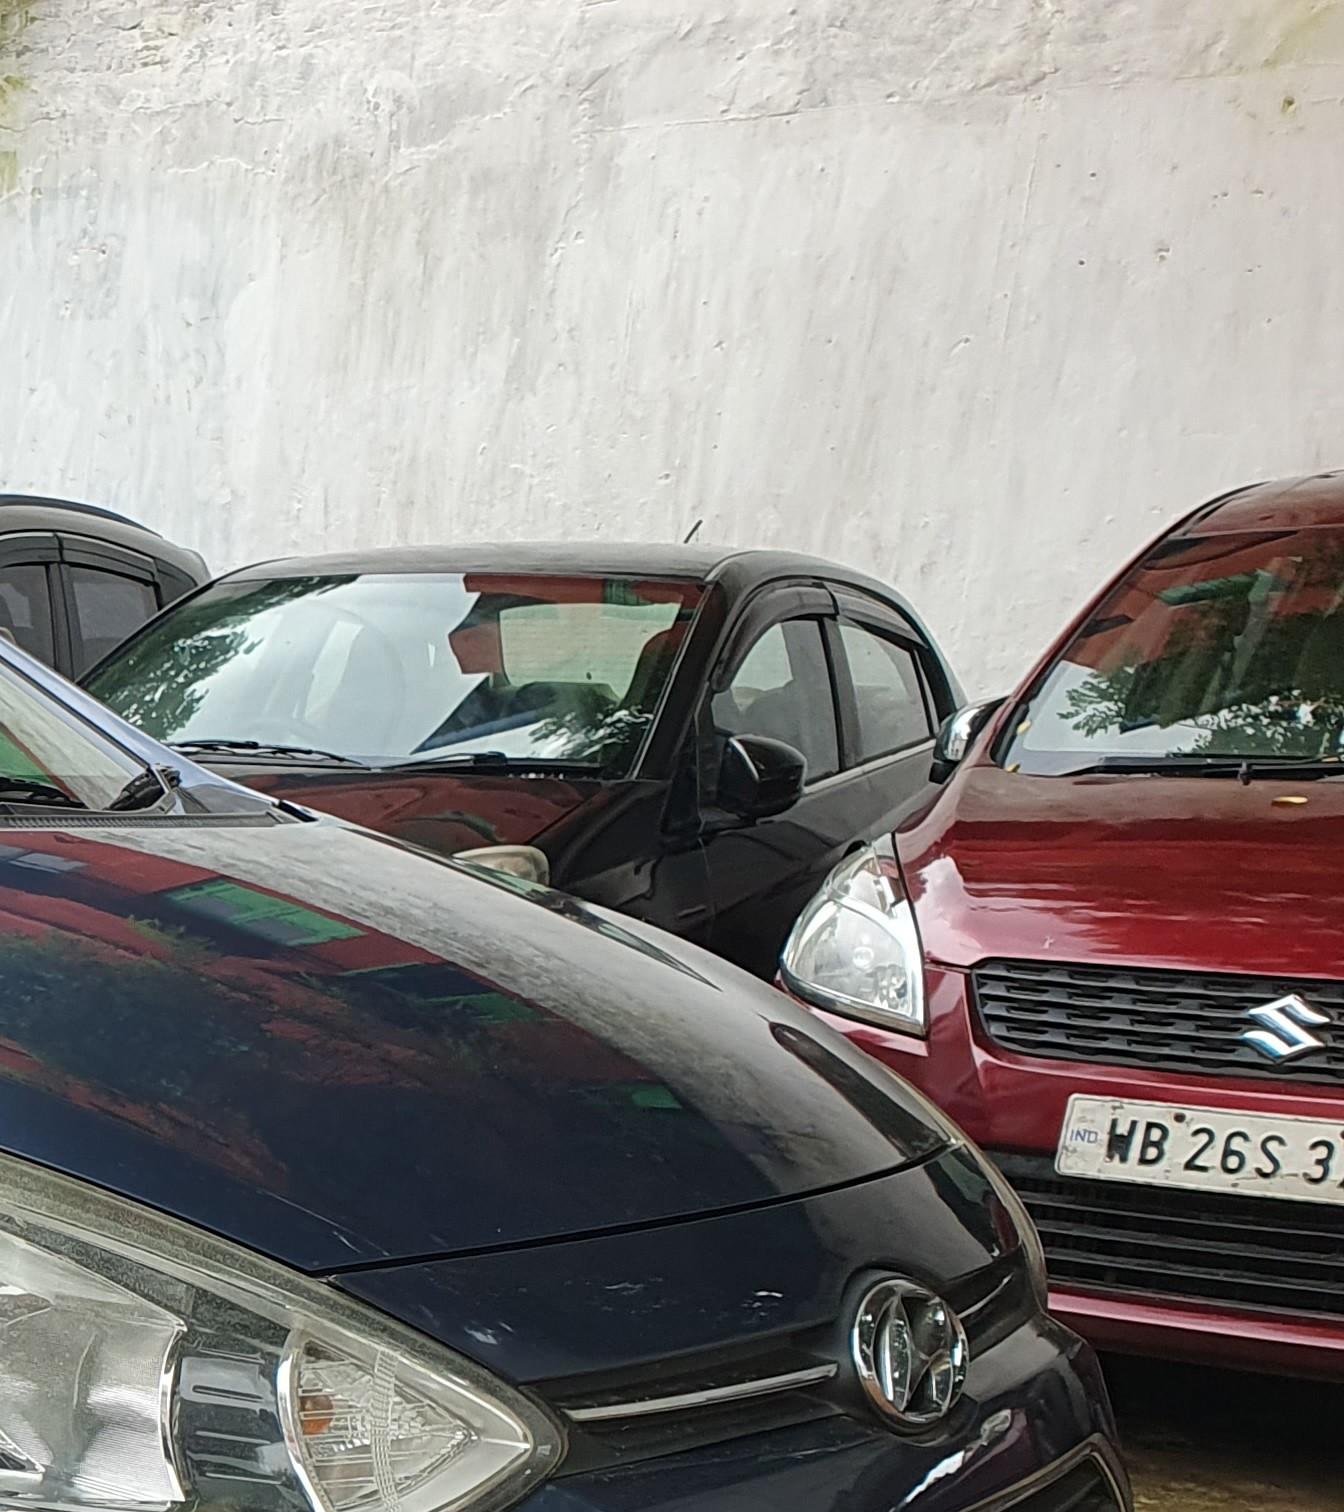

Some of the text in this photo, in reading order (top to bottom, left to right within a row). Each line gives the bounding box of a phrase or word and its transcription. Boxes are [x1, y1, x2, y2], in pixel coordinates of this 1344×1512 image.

[1069, 1128, 1100, 1145] IND
[1106, 1117, 1170, 1166] WB
[1301, 1139, 1344, 1188] 3
